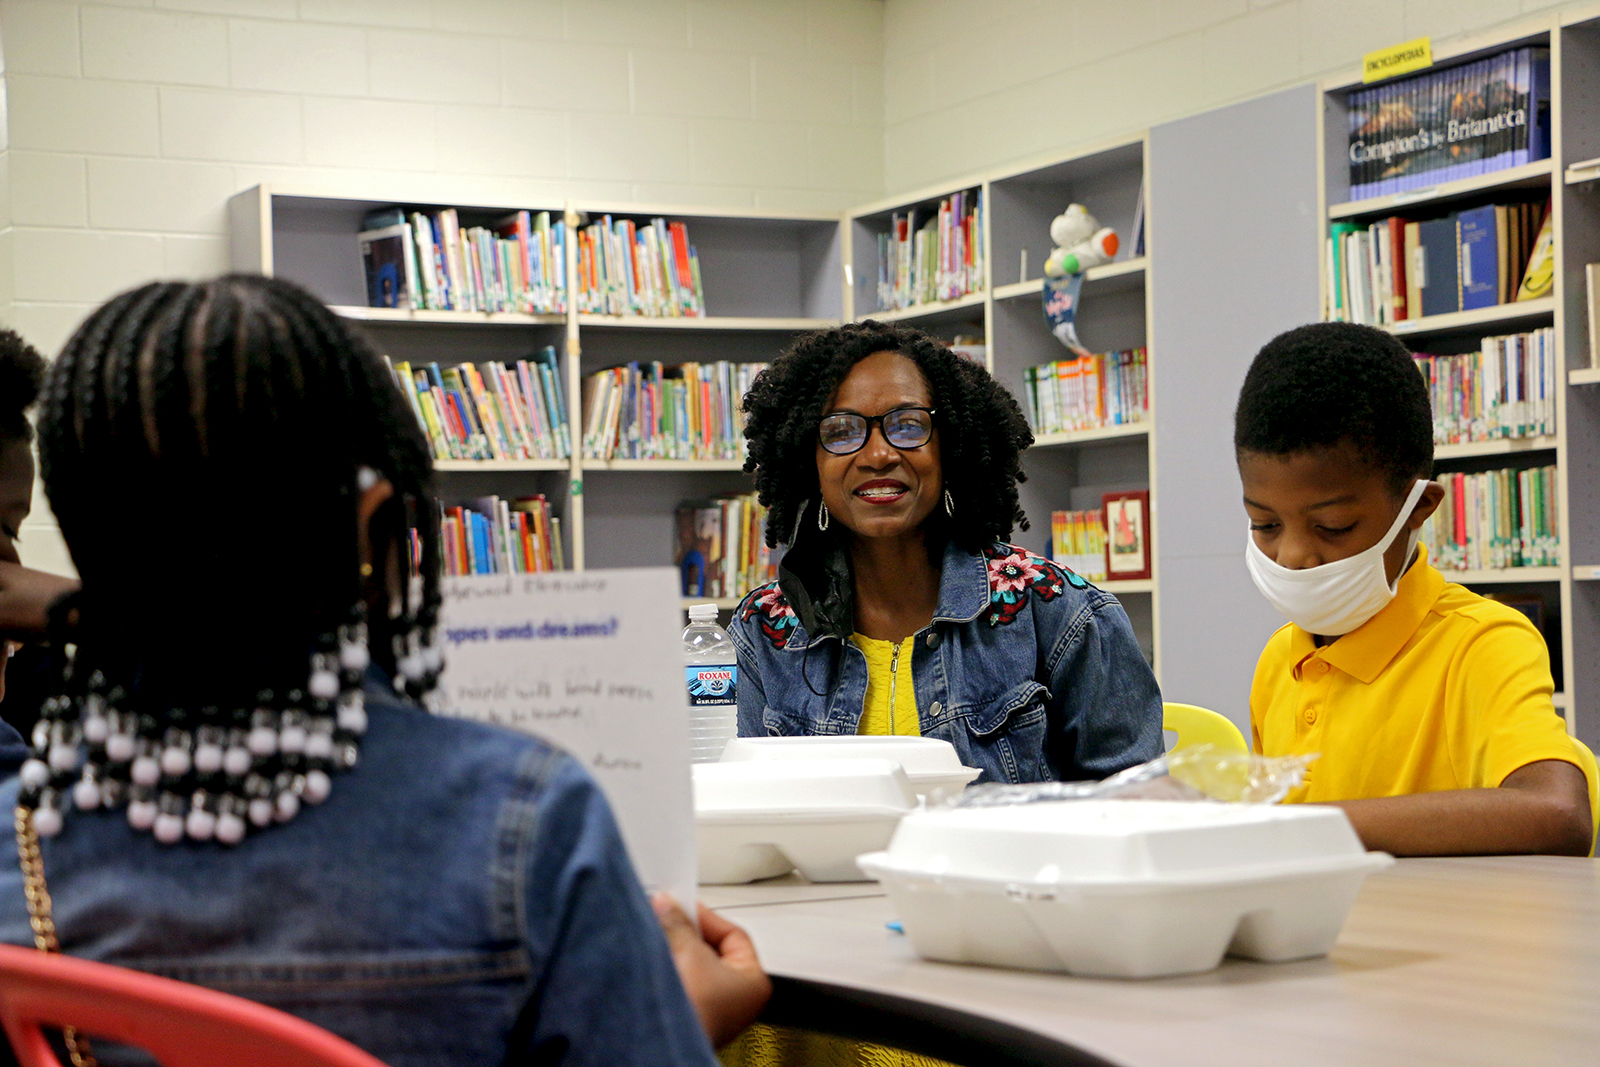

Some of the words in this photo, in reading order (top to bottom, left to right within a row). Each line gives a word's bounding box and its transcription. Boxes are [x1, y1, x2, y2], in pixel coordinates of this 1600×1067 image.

[494, 621, 534, 641] and
[536, 616, 619, 639] dreams?
[699, 671, 731, 681] ROXANE
